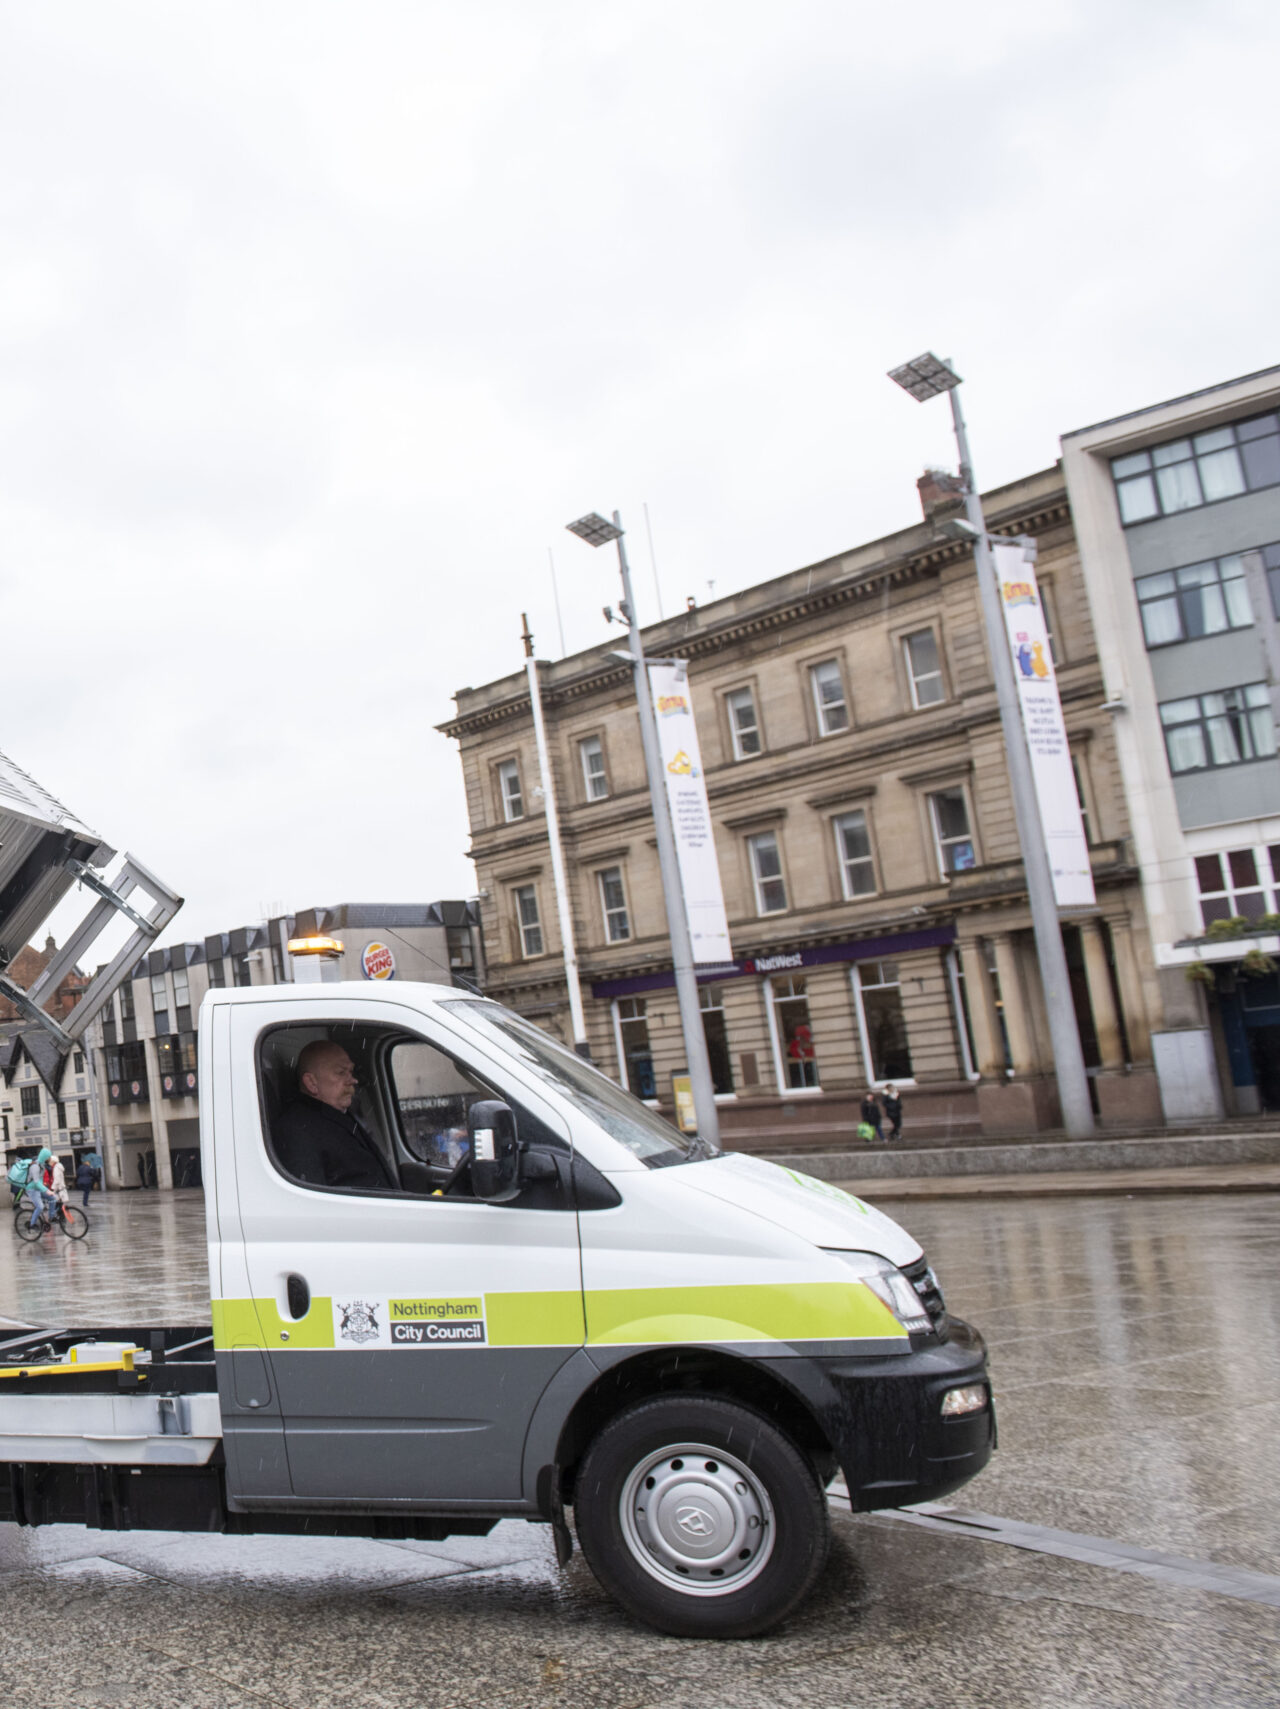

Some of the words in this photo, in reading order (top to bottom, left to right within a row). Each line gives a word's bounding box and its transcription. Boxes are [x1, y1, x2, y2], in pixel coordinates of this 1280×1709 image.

[365, 949, 389, 966] BURGER
[368, 955, 392, 977] KING
[755, 952, 803, 972] NatWest
[393, 1302, 478, 1318] Nottingham
[394, 1325, 423, 1342] City
[426, 1324, 481, 1339] Council
